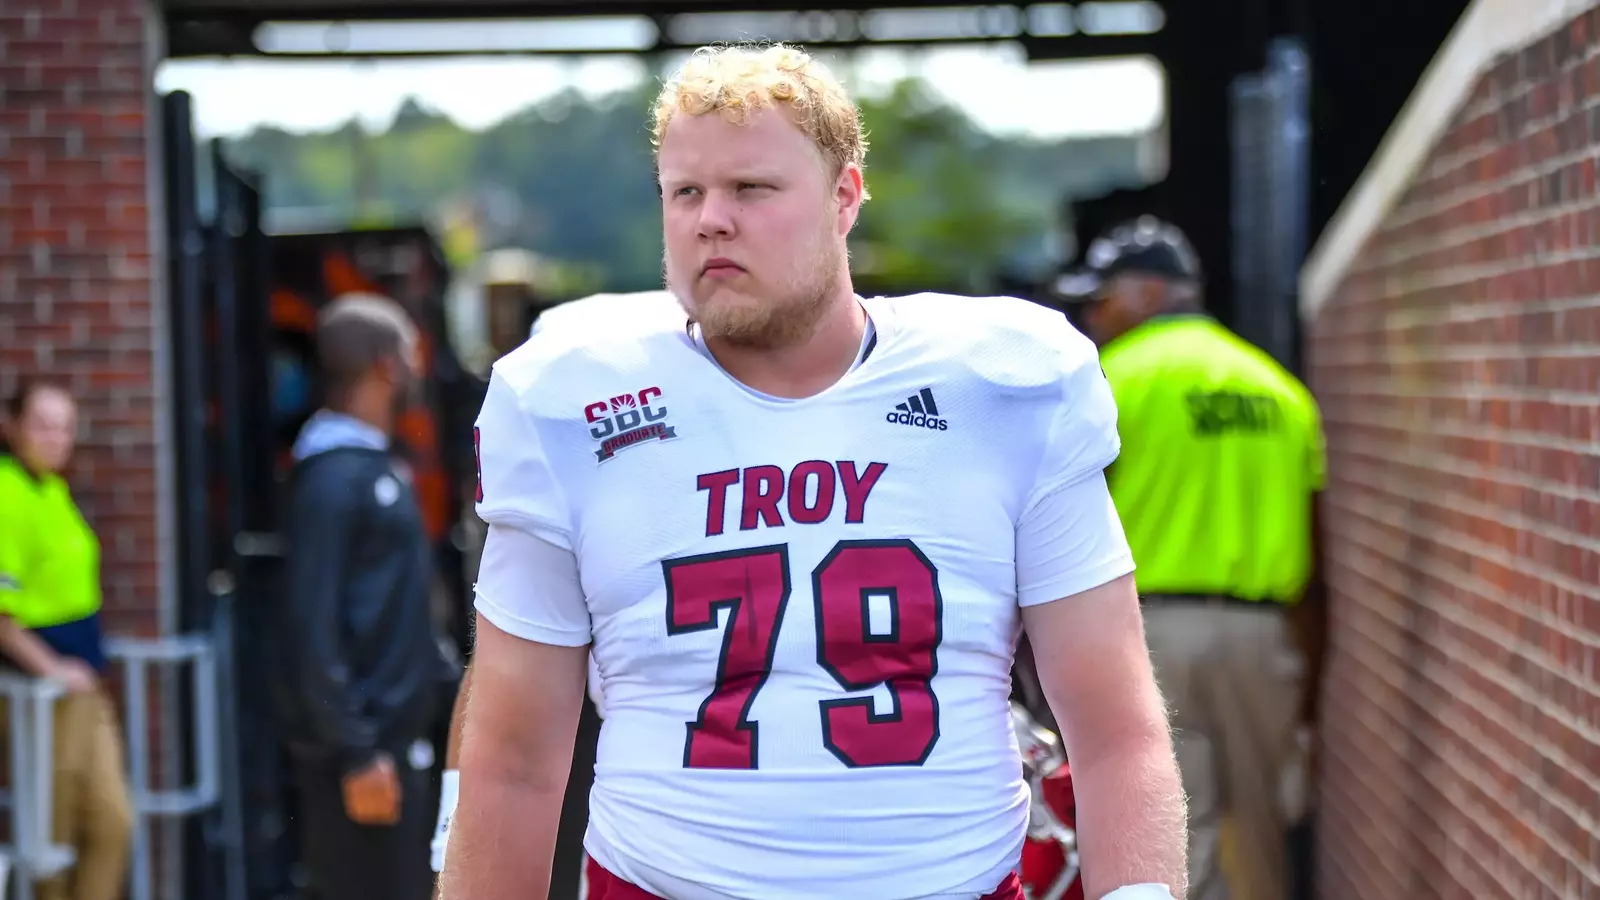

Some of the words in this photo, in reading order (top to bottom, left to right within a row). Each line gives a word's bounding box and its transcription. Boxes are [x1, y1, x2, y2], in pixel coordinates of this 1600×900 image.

[584, 387, 667, 439] SBC
[886, 411, 948, 431] adidas
[603, 424, 665, 455] GRADUATE
[696, 459, 888, 537] TROY
[661, 538, 943, 770] 79
